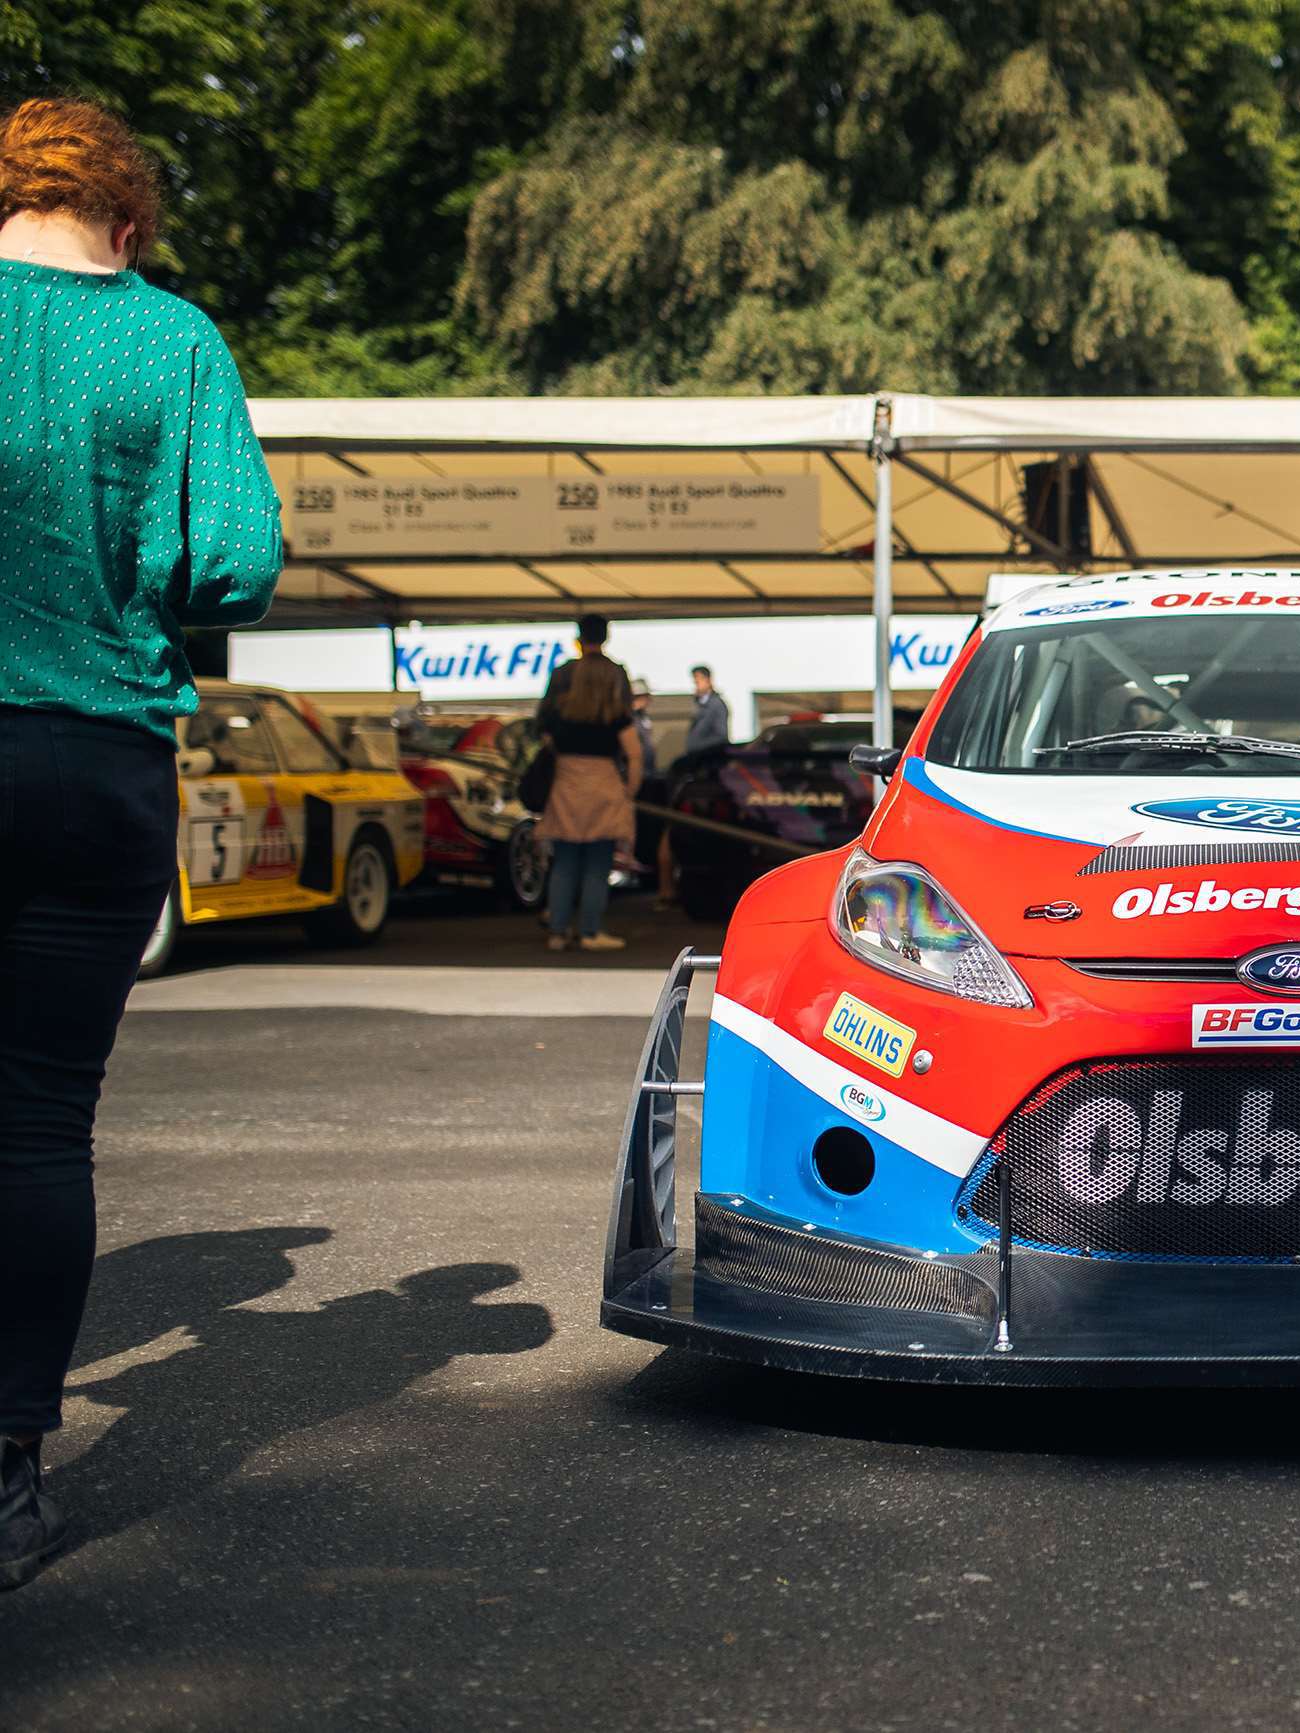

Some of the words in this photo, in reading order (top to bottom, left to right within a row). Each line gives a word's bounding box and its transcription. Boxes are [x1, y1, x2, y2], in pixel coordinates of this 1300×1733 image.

[294, 486, 335, 509] 250
[383, 485, 415, 500] Audi
[419, 485, 460, 502] Sport
[462, 484, 520, 501] Quattro
[558, 484, 598, 507] 250
[649, 484, 680, 498] Audi
[686, 484, 726, 500] Sport
[728, 483, 786, 499] Quattro
[1040, 600, 1115, 616] Ford
[746, 791, 845, 807] ADVAN
[210, 823, 227, 882] 5
[833, 1000, 903, 1064] ÖHLINS
[848, 1087, 874, 1110] BGM
